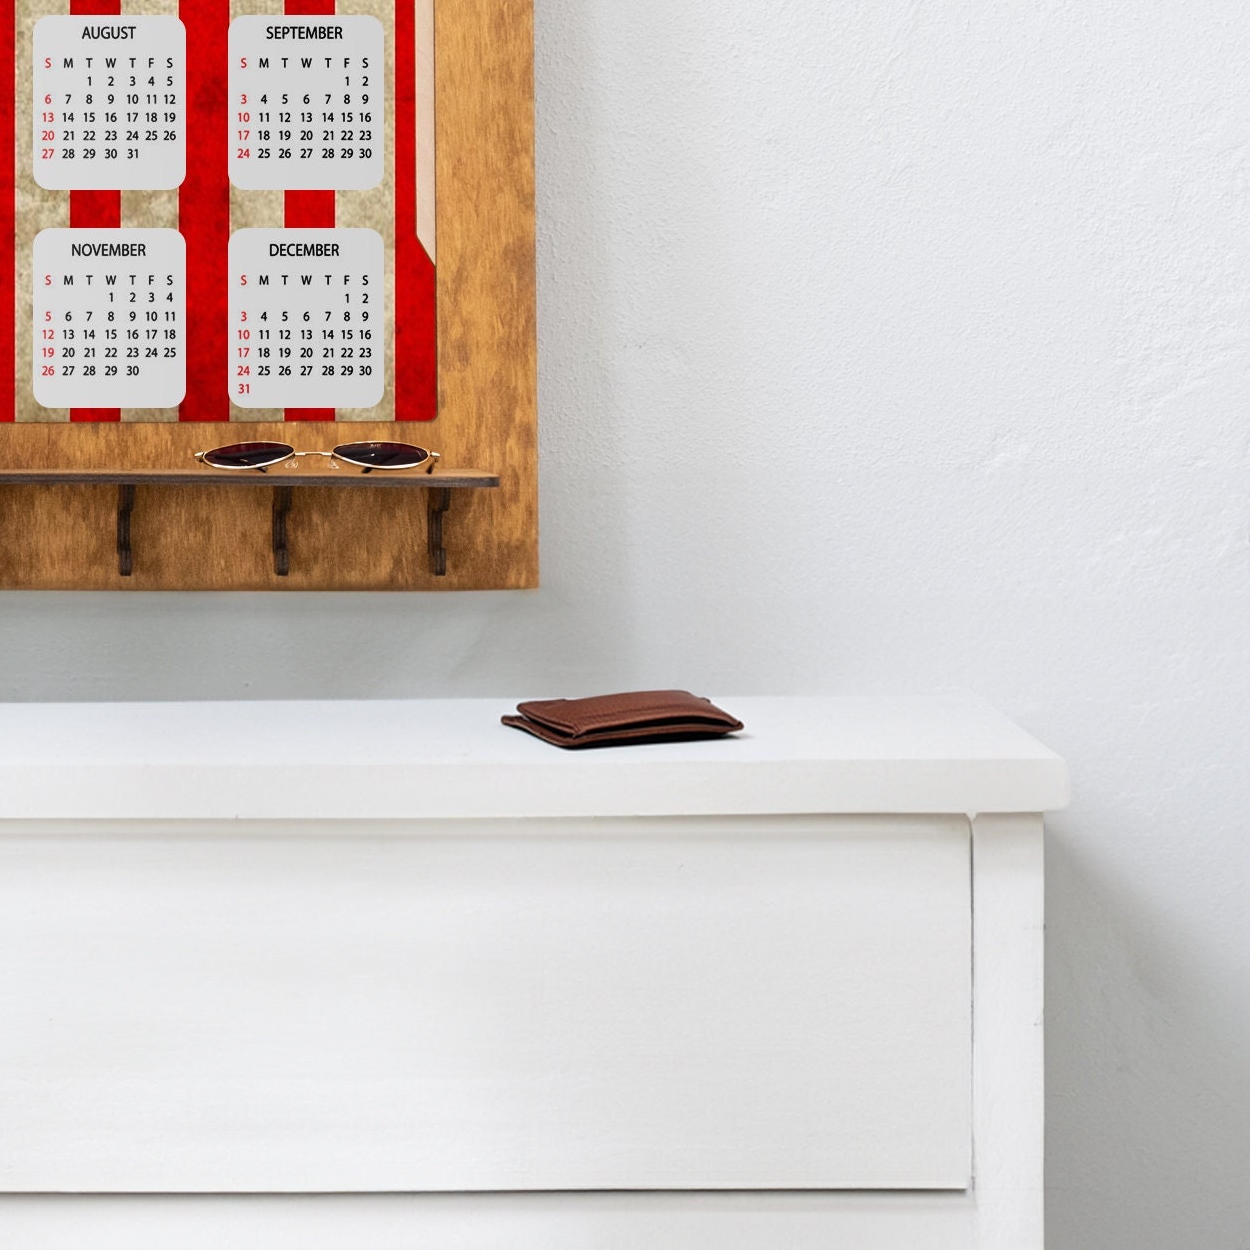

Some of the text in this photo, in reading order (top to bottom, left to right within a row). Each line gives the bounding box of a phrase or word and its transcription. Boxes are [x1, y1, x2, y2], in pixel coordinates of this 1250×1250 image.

[81, 25, 137, 40] AUGUST
[265, 25, 343, 40] SEPTEMBER
[240, 57, 369, 69] S M T W T F S
[41, 129, 177, 142] 20 21 22 23 24 25 26
[237, 129, 372, 142] 17 18 19 20 21 22 23
[71, 242, 147, 257] NOVEMBER
[269, 242, 340, 257] DECEMBER
[45, 274, 174, 287] S M T W T F S
[361, 292, 369, 304] 2
[42, 346, 177, 359] 19 20 21 22 23 24 25
[237, 365, 373, 377] 24 25 26 27 28 29 30
[238, 383, 250, 395] 31
